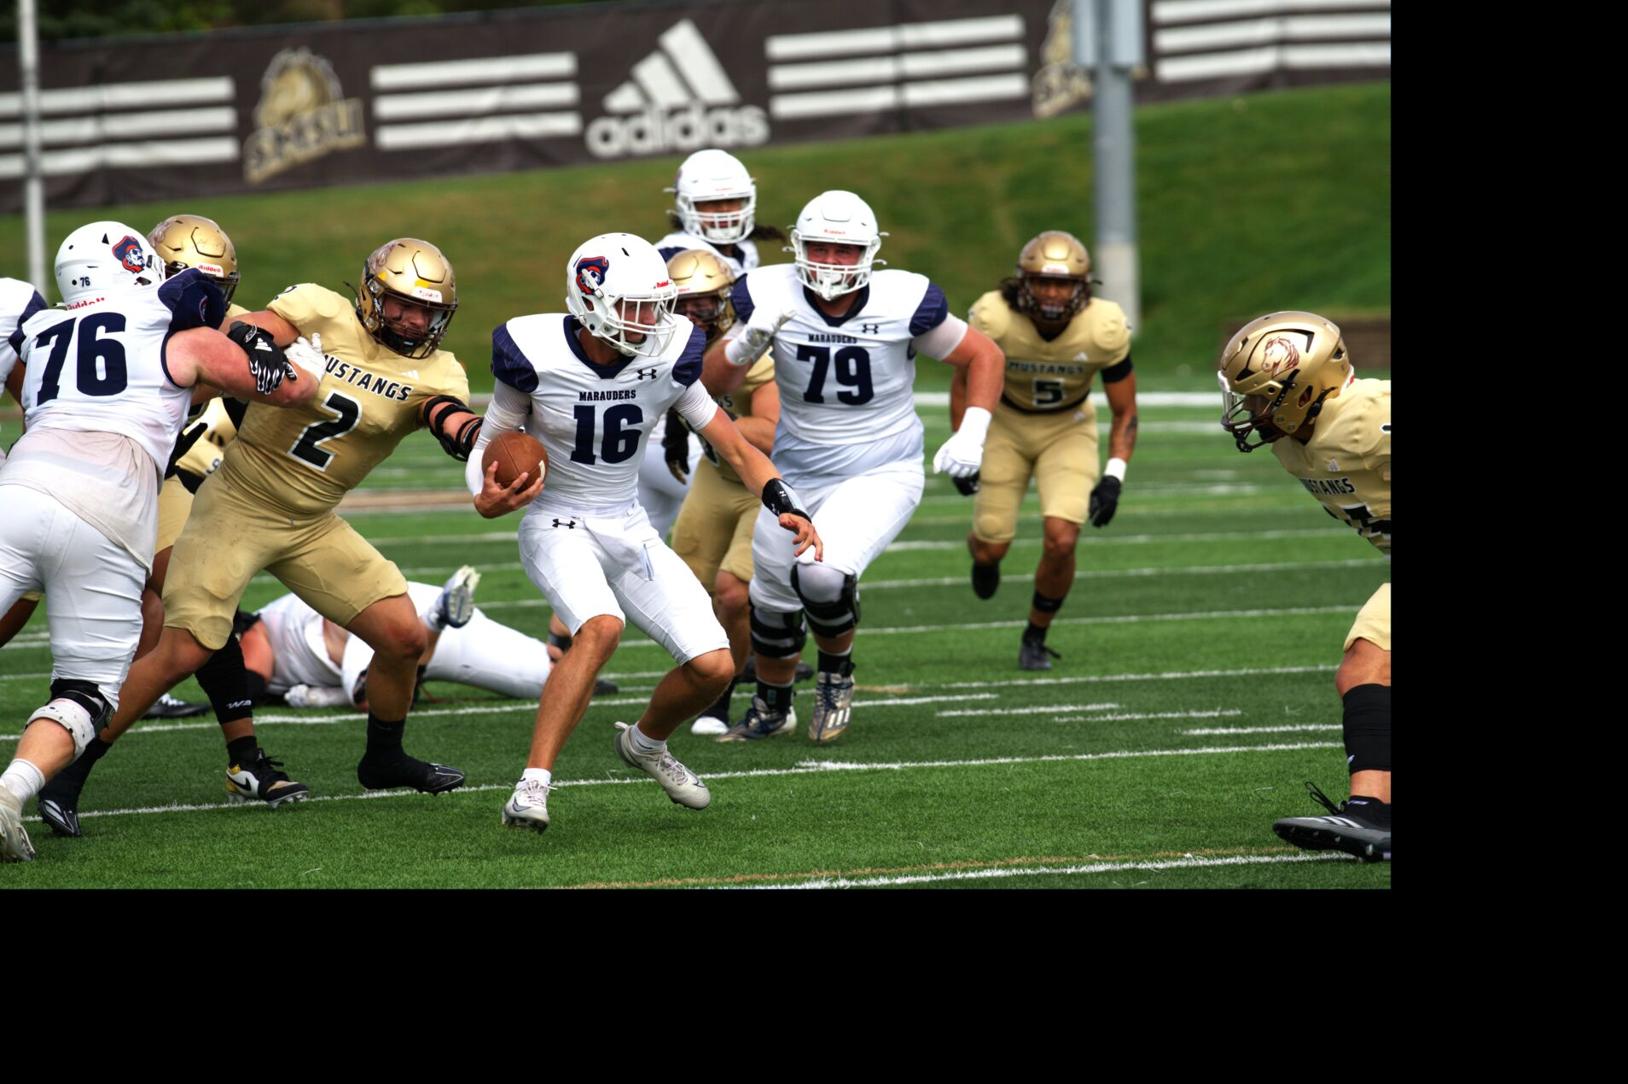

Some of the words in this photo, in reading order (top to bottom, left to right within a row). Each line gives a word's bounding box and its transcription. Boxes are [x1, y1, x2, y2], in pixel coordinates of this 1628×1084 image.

[585, 105, 770, 158] adidas
[79, 276, 91, 288] 76
[35, 311, 129, 407] 76
[807, 333, 858, 345] MARAUDERS
[324, 354, 412, 401] USTANGS
[578, 389, 637, 401] MARAUDERS
[796, 344, 875, 406] 79
[1032, 378, 1067, 409] 5
[288, 388, 363, 472] 2
[570, 403, 644, 465] 16
